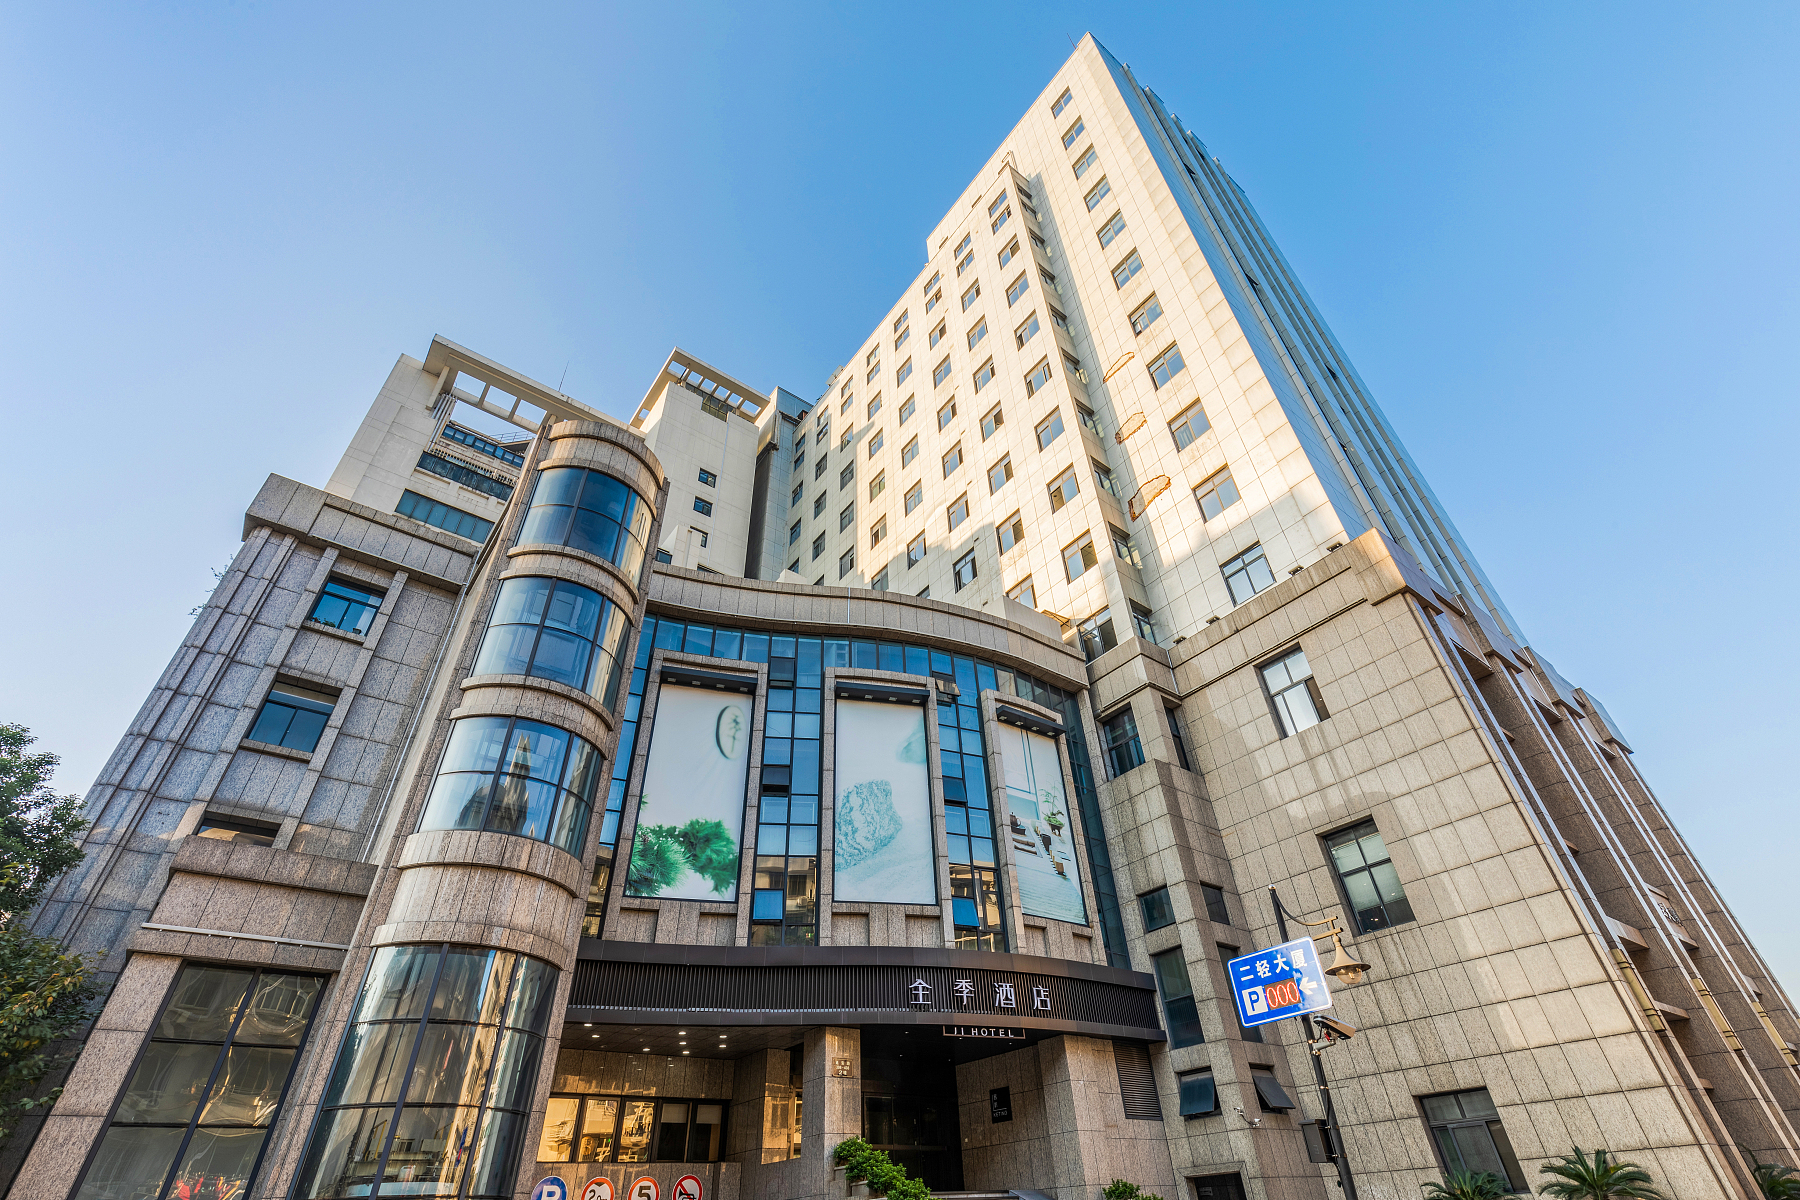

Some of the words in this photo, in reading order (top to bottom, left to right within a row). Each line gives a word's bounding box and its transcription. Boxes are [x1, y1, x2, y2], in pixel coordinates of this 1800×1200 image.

[1239, 948, 1308, 981] 二轻大厦
[909, 978, 1051, 1011] 全季酒店
[1266, 981, 1300, 1008] 000
[971, 1027, 1014, 1038] HOTEL
